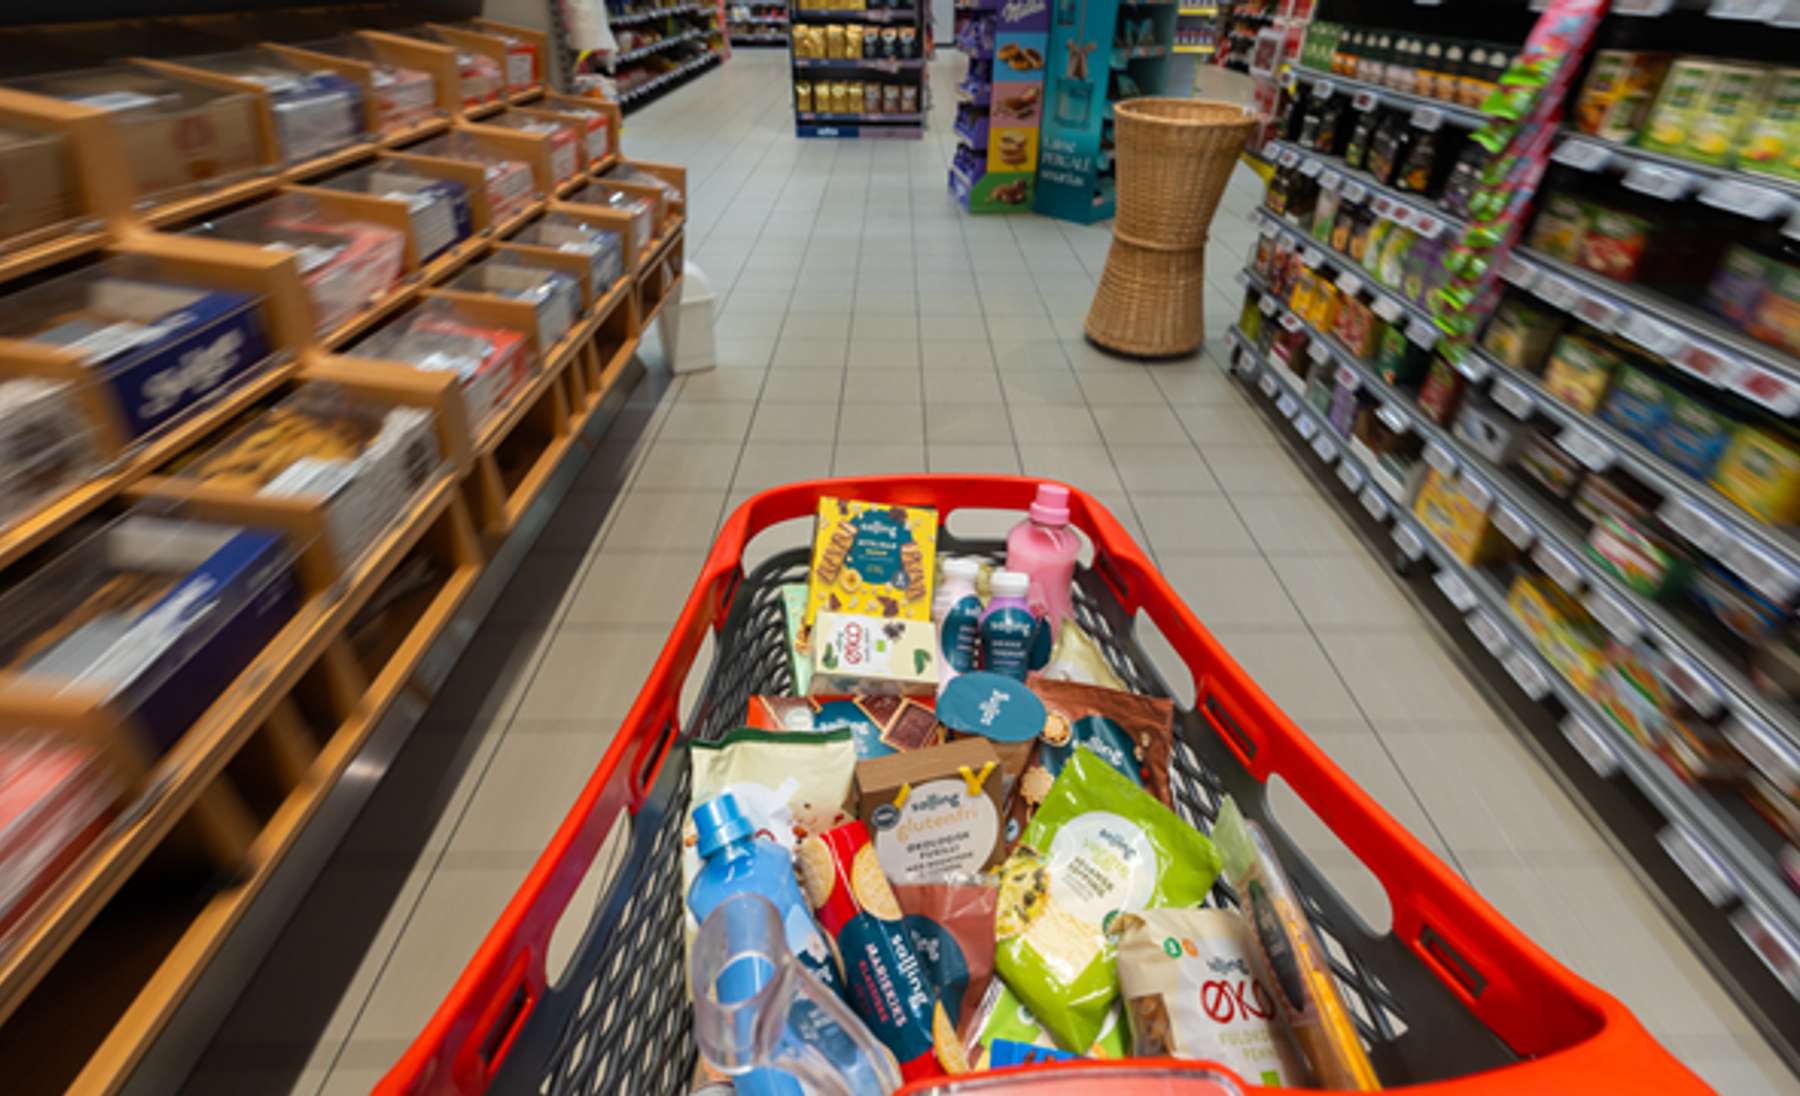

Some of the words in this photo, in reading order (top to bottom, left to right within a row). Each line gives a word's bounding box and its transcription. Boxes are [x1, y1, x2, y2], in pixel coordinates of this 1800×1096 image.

[896, 806, 978, 845] glutenfri
[891, 933, 928, 1010] salling
[1201, 979, 1276, 1024] ØKO
